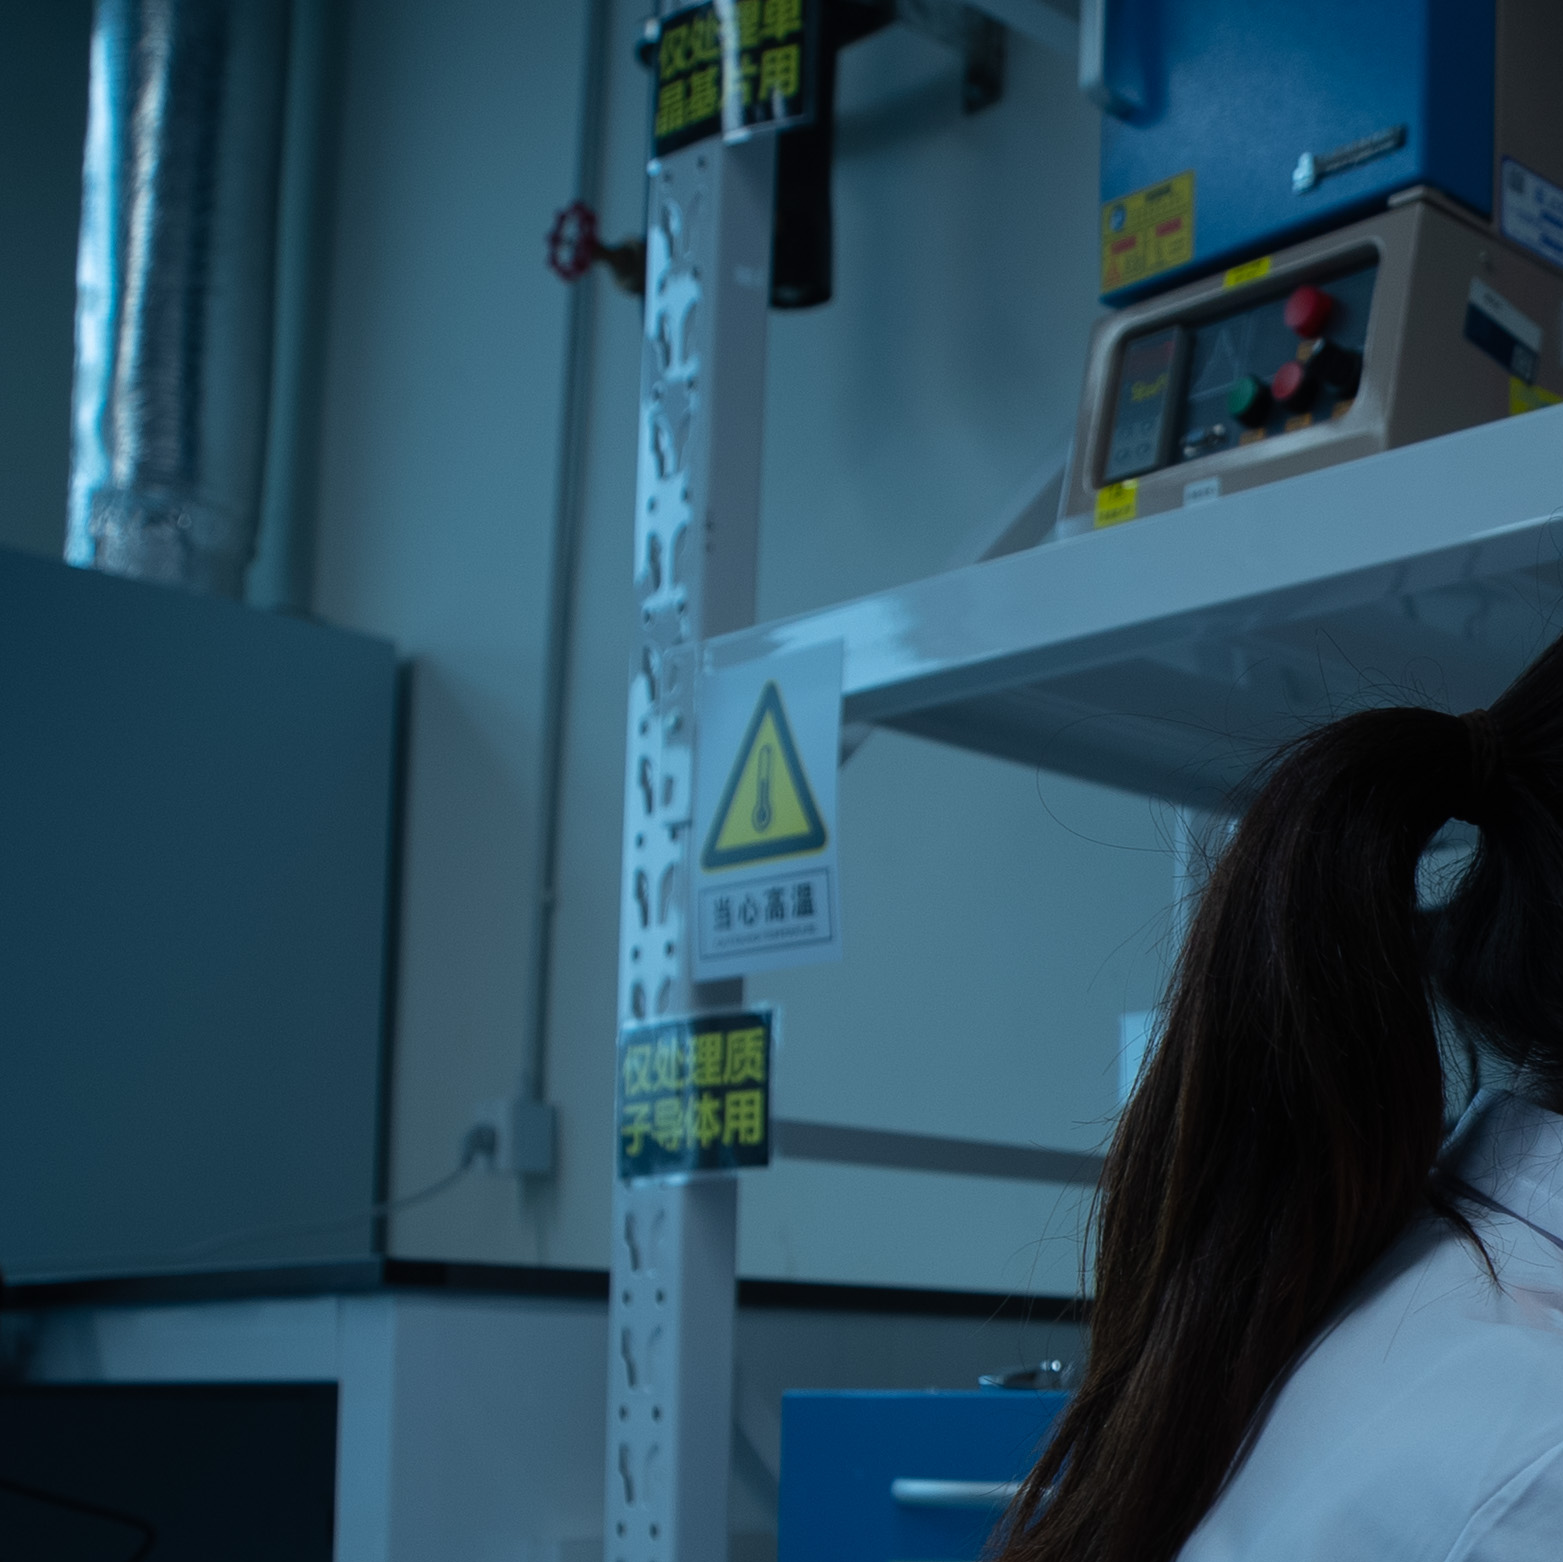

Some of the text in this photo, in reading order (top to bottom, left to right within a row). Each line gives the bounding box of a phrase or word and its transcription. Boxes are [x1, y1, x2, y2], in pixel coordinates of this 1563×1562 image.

[713, 881, 815, 932] 当心高温
[623, 1026, 766, 1096] 仅处理质
[620, 1088, 764, 1158] 子导体用
